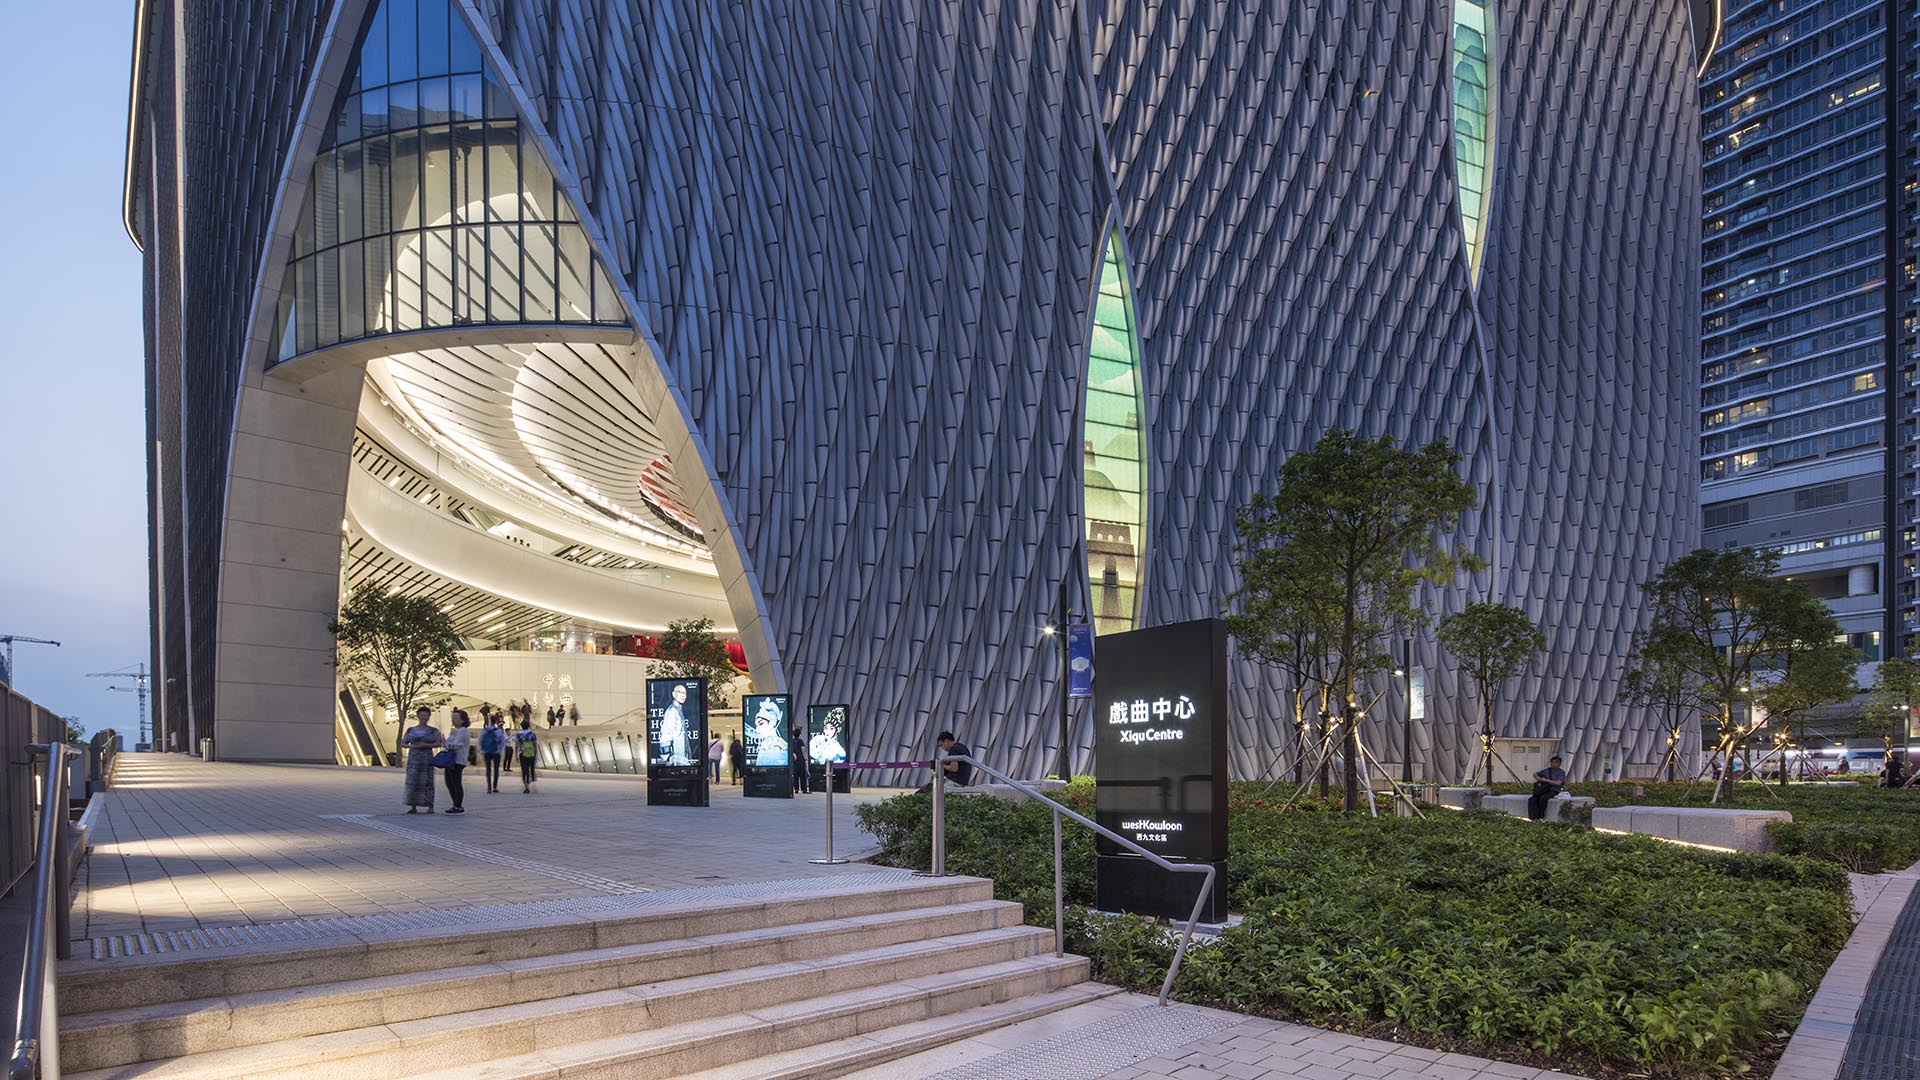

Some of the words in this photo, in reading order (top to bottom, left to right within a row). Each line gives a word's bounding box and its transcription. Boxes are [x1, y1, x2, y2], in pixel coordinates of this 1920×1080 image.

[1109, 695, 1196, 724] 戲曲中心
[1122, 819, 1183, 831] westKowloon
